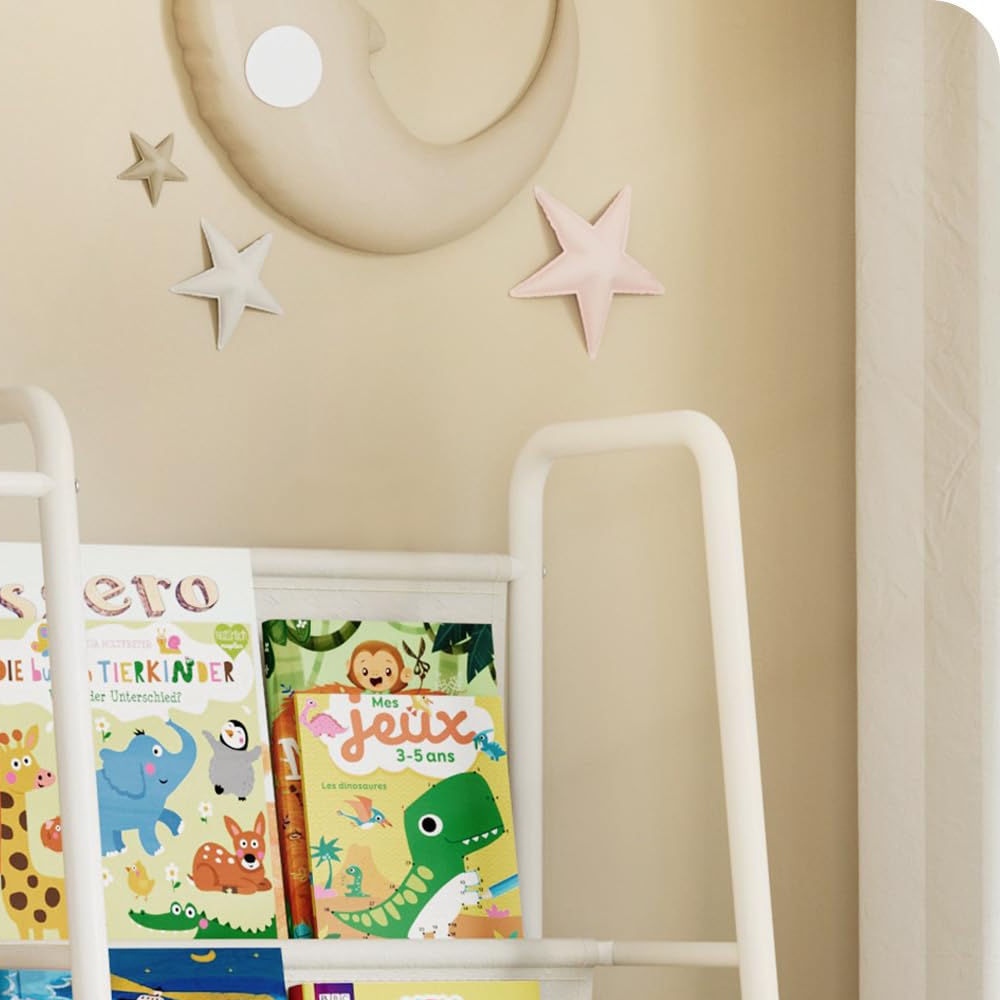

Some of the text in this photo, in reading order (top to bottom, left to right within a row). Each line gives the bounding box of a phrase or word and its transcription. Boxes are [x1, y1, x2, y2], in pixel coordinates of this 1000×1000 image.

[98, 657, 235, 683] TIERKINDER
[110, 689, 183, 703] Unterschied?
[371, 696, 399, 709] Mes
[340, 708, 477, 763] jeux
[396, 748, 455, 763] 3-5 ans
[321, 782, 387, 790] Les dinosaures
